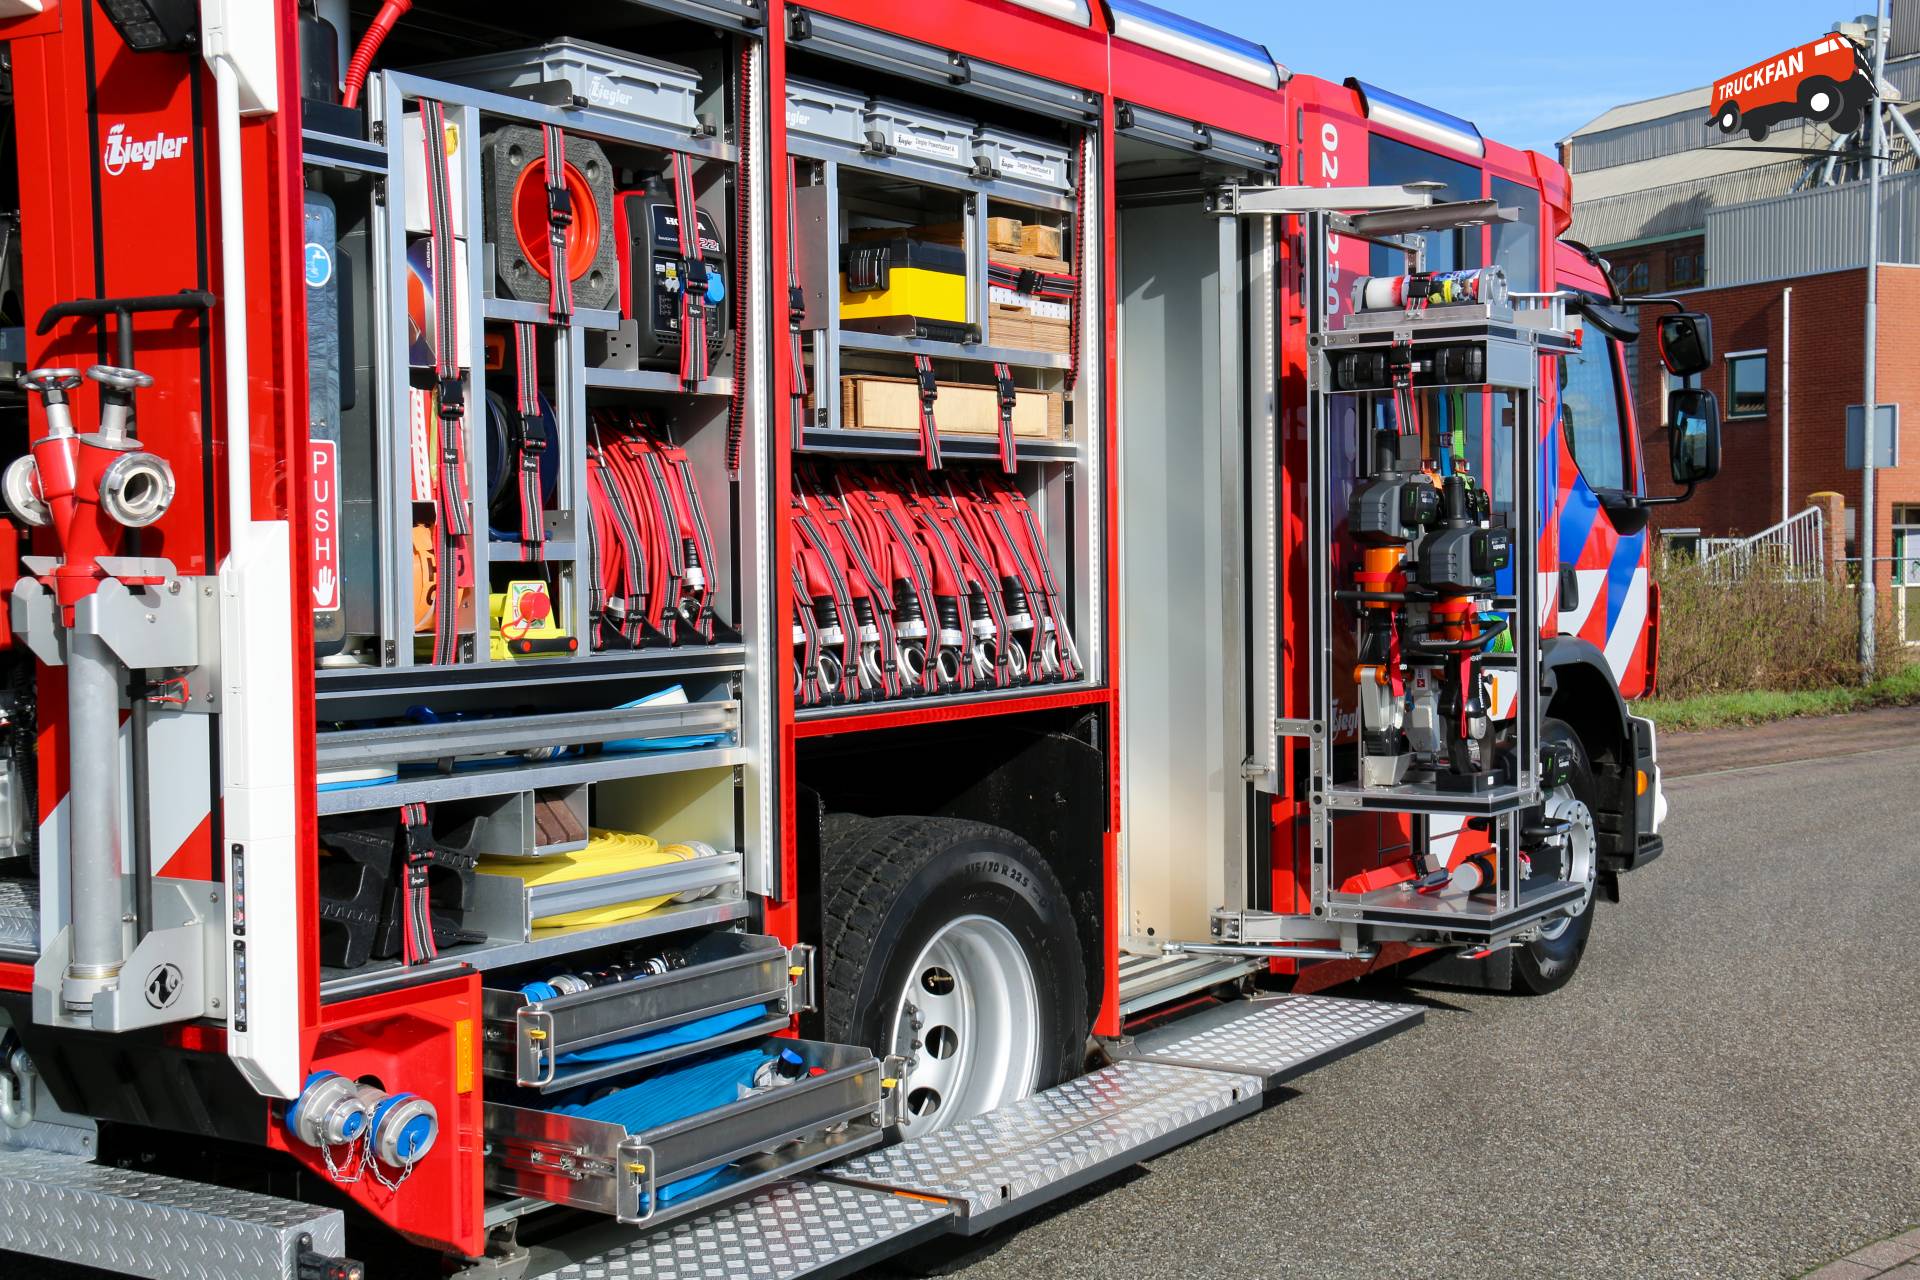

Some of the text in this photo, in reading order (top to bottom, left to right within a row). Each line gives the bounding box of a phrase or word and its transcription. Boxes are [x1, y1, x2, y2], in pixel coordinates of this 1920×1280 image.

[786, 110, 811, 126] egler
[104, 123, 188, 176] Ziegler
[312, 450, 331, 561] PUSH
